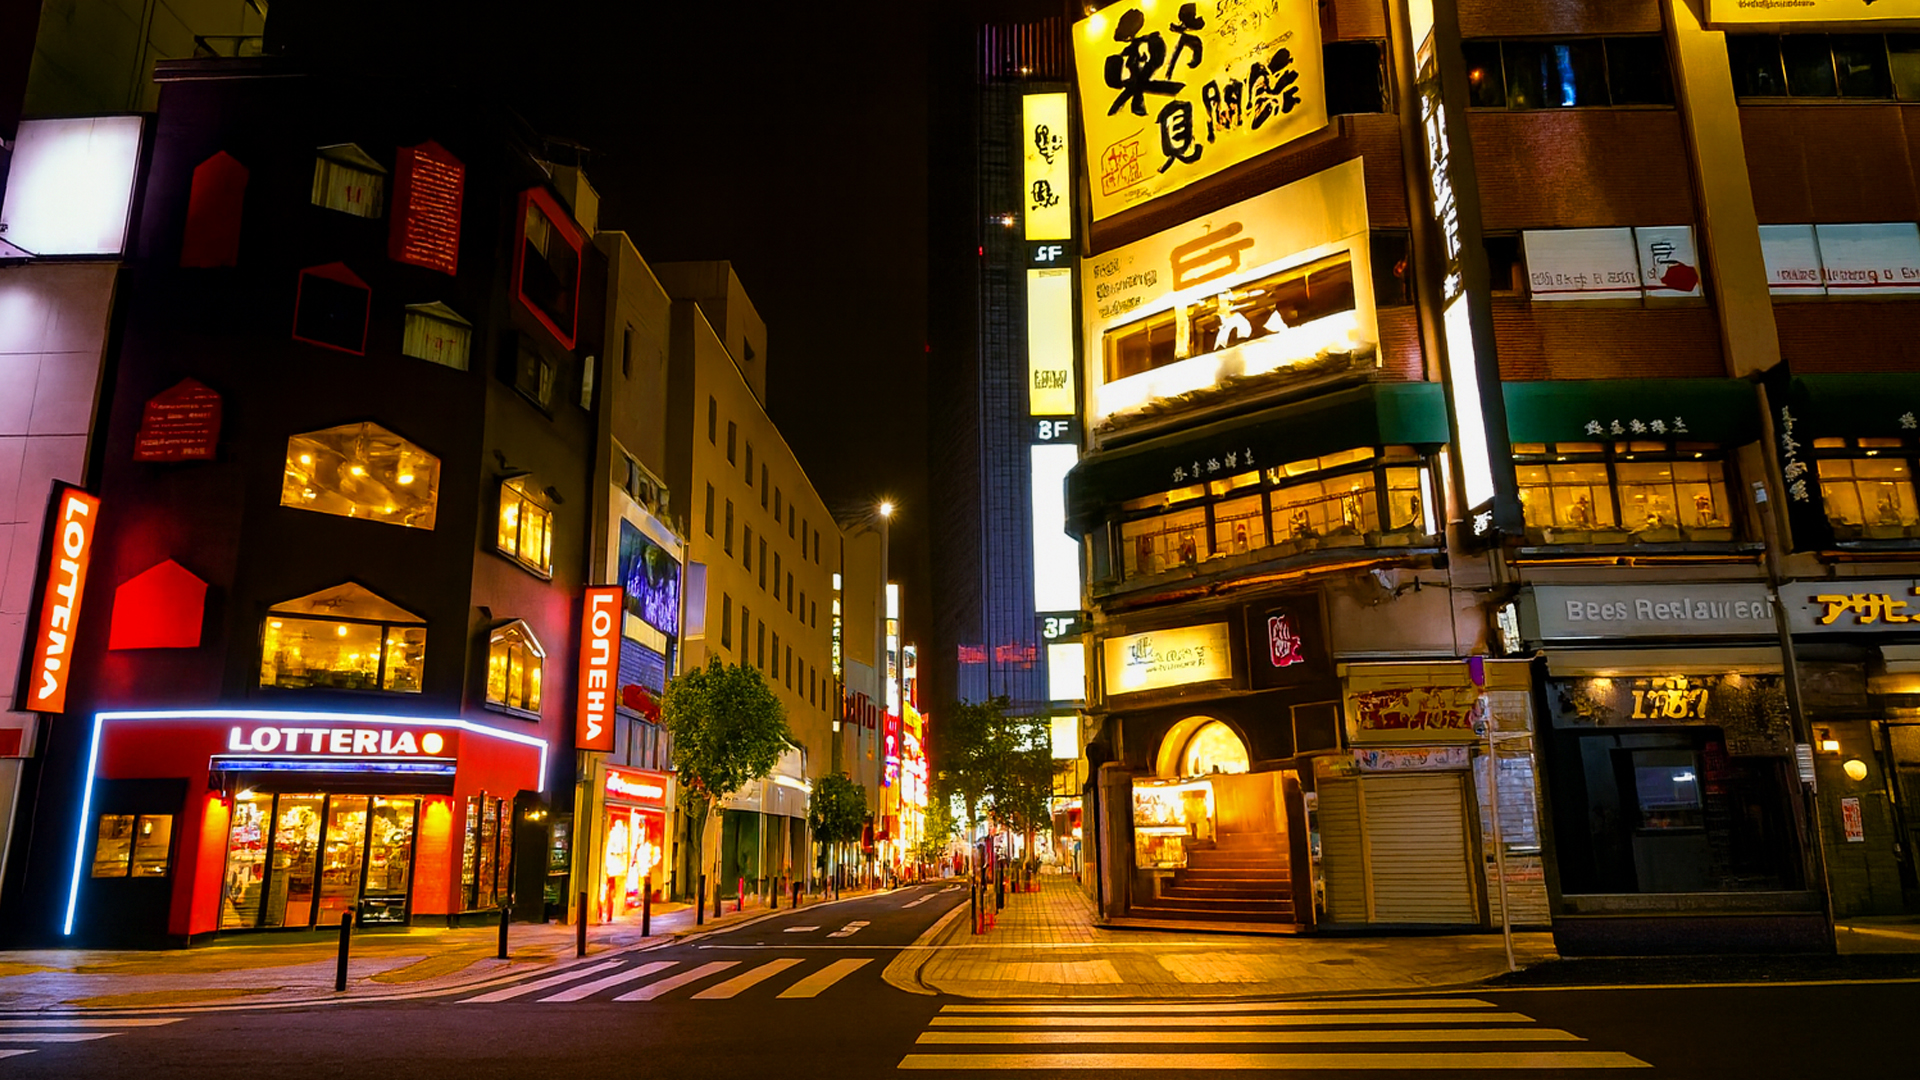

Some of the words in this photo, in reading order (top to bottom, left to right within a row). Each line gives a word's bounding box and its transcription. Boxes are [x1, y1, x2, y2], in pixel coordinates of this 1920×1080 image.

[1817, 586, 1920, 624] アサヒ
[228, 727, 418, 753] LOTTERIA
